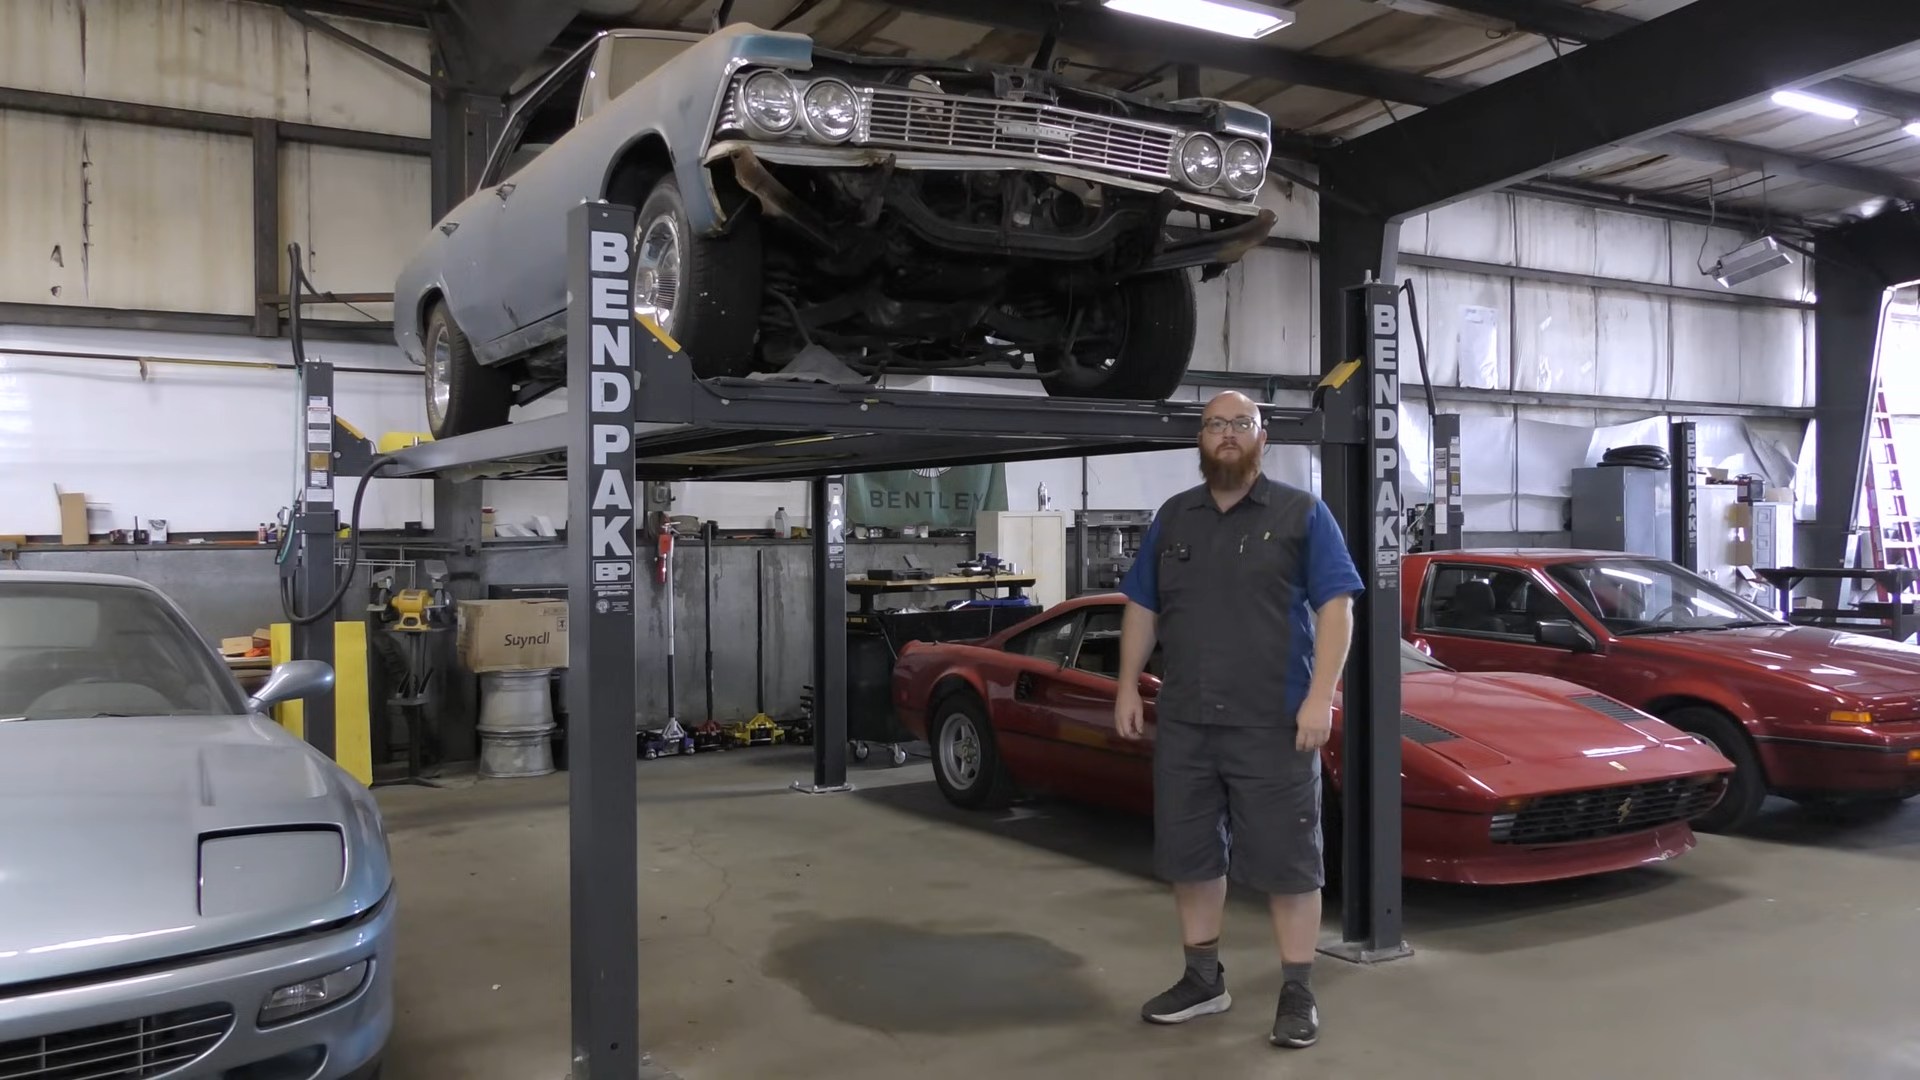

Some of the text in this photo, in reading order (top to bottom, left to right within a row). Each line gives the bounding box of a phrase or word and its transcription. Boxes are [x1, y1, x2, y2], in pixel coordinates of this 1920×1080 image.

[591, 231, 632, 556] BENDPAK
[1373, 304, 1398, 547] BENDPAK
[870, 490, 986, 510] BENTLEY
[1687, 430, 1697, 530] BENDPAK
[595, 562, 631, 581] BP
